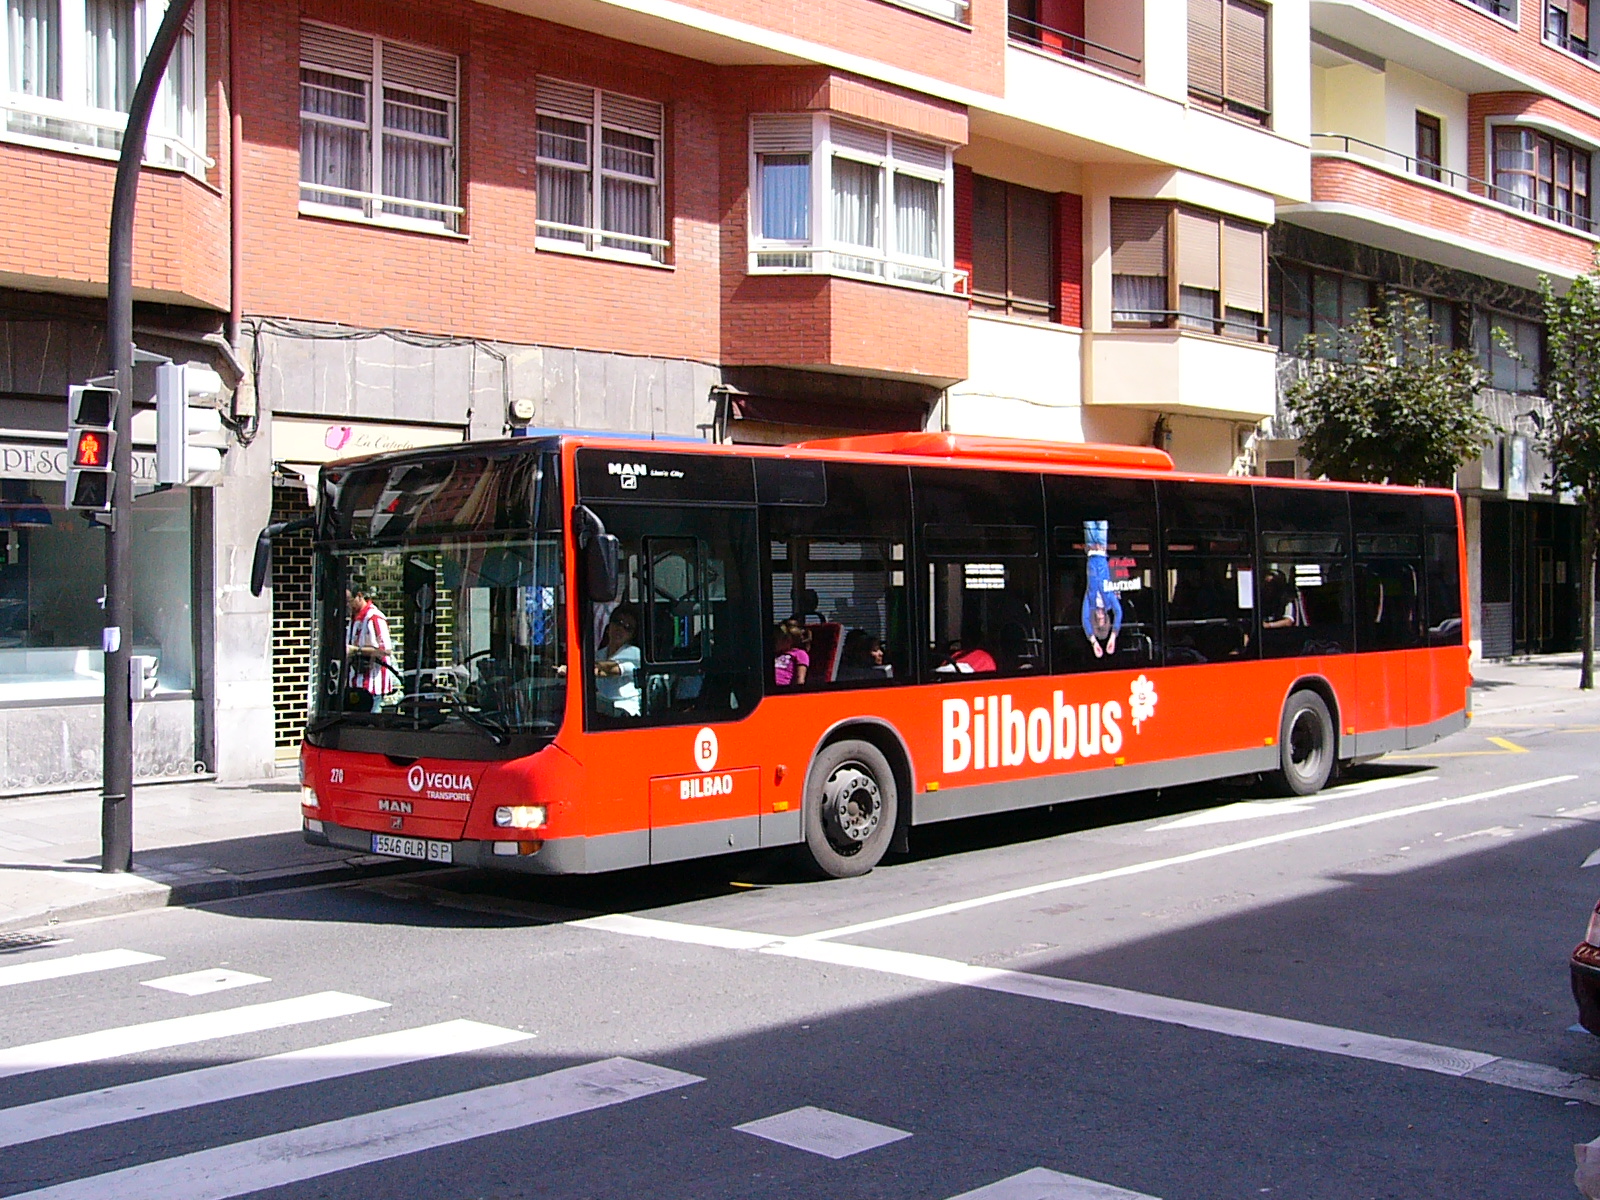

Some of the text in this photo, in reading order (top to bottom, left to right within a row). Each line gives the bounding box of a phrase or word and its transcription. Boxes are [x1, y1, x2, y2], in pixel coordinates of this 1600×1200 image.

[608, 462, 648, 476] MAN
[942, 690, 1123, 774] Bilbobus
[701, 740, 712, 759] B
[330, 768, 344, 784] 270
[425, 773, 473, 790] VEOLIA
[680, 774, 733, 800] BILBAO
[426, 790, 471, 802] TRANSPORTE
[378, 799, 412, 813] MAN
[377, 837, 424, 857] 5546 GLR
